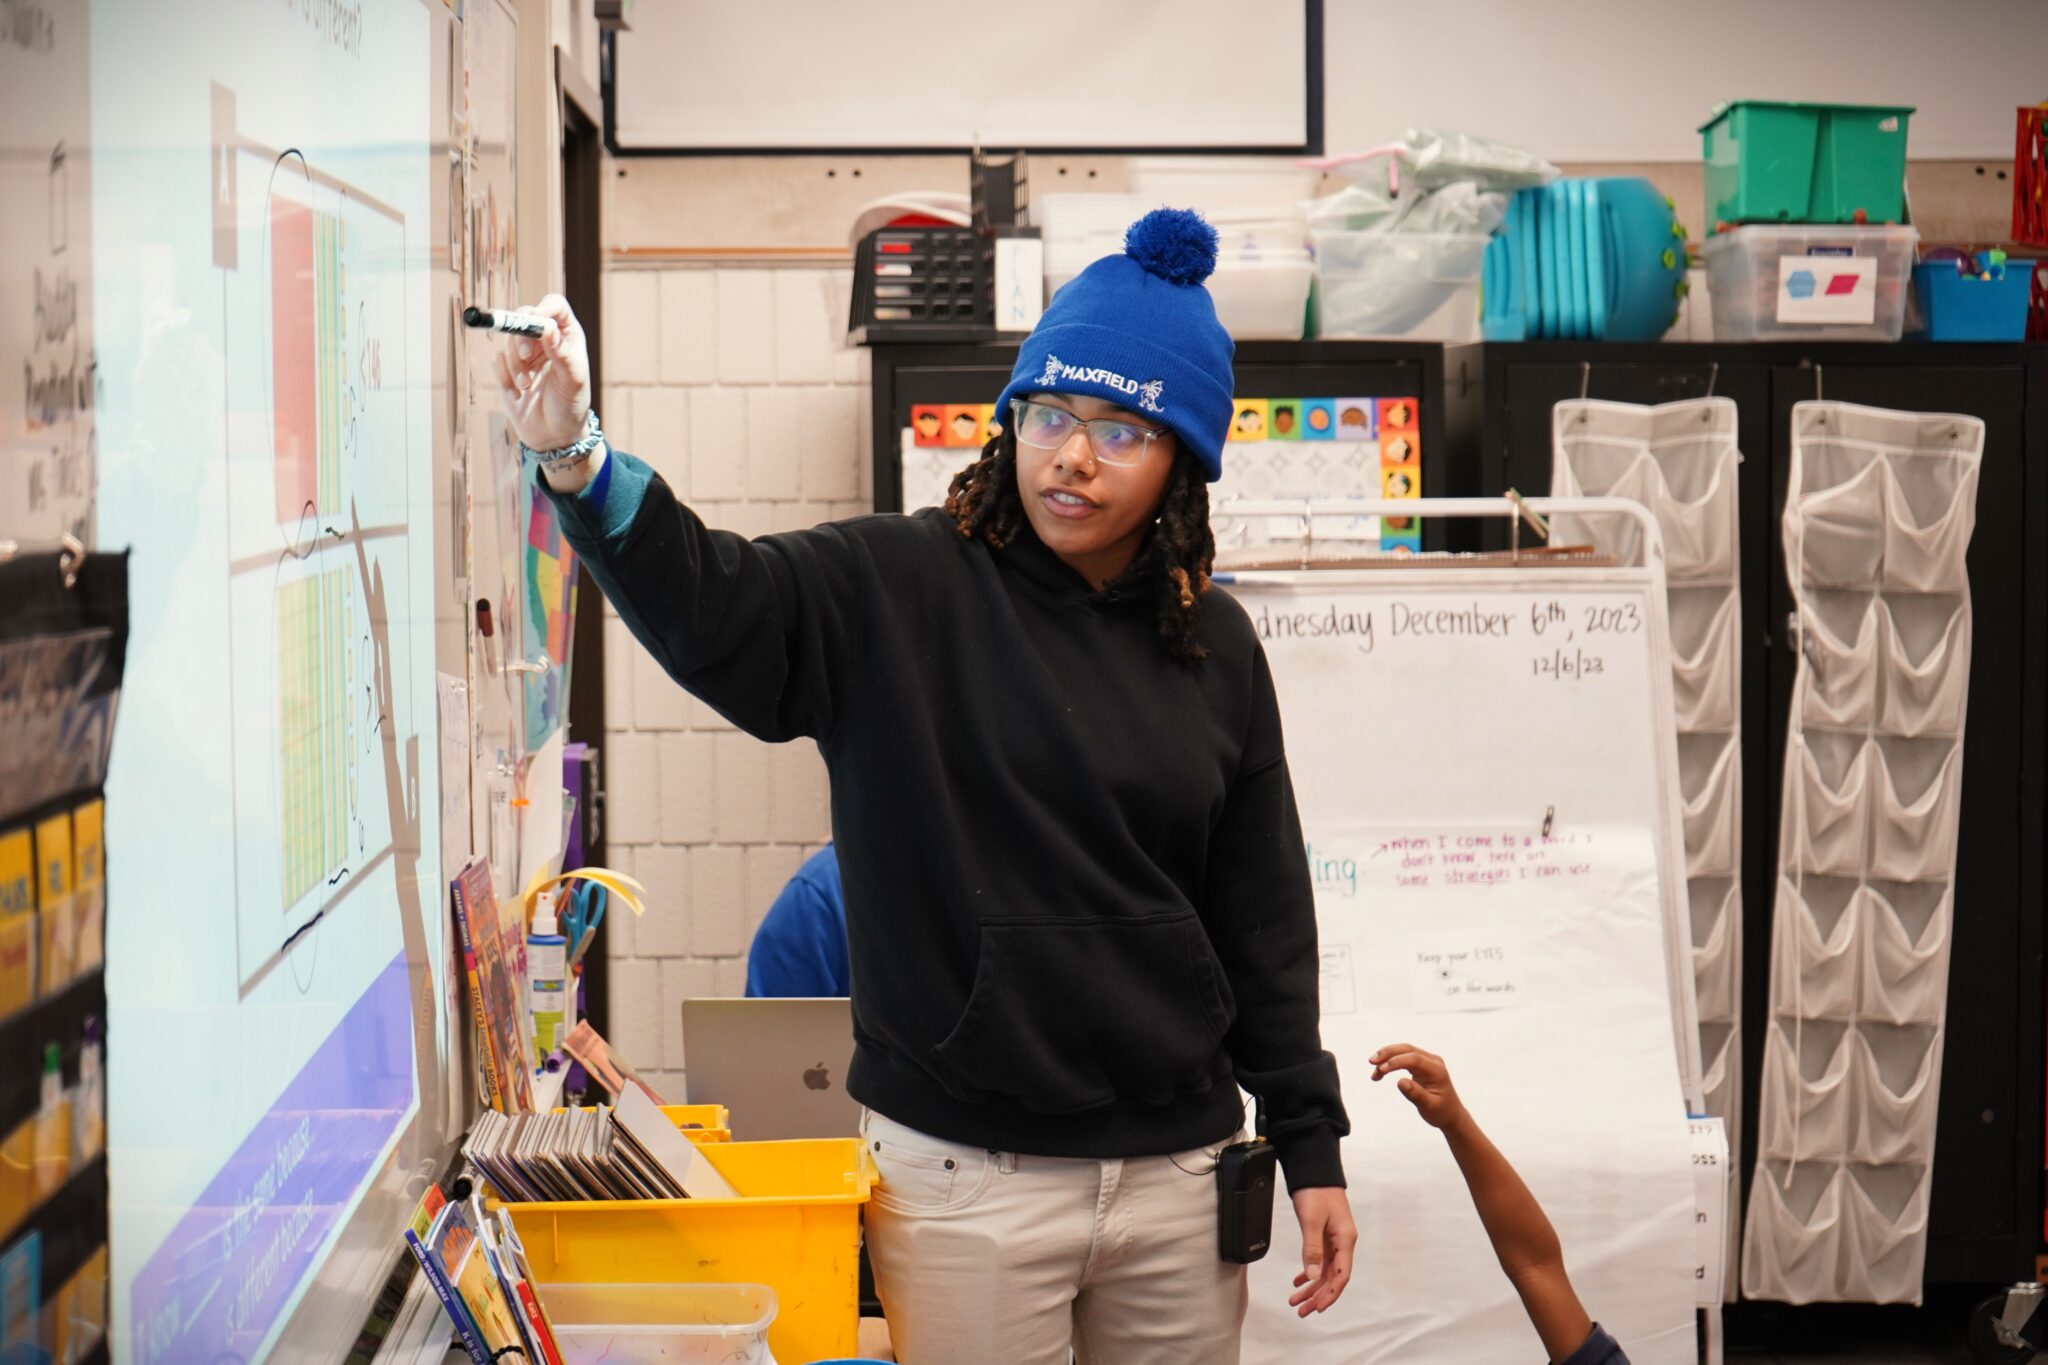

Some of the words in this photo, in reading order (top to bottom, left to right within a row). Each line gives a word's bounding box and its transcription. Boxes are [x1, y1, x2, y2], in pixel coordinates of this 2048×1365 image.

[1061, 364, 1138, 394] MAXFIELD
[1256, 604, 1374, 653] dnesday
[1391, 602, 1516, 637] December
[1585, 602, 1641, 634] 2023
[1533, 648, 1604, 680] 12/6/23
[1456, 836, 1493, 848] come
[1502, 832, 1516, 847] to
[1535, 865, 1562, 877] can
[460, 920, 470, 948] THOMAS
[471, 986, 485, 1026] STACEY'S
[488, 1068, 498, 1097] BOOKS
[466, 1339, 474, 1349] is
